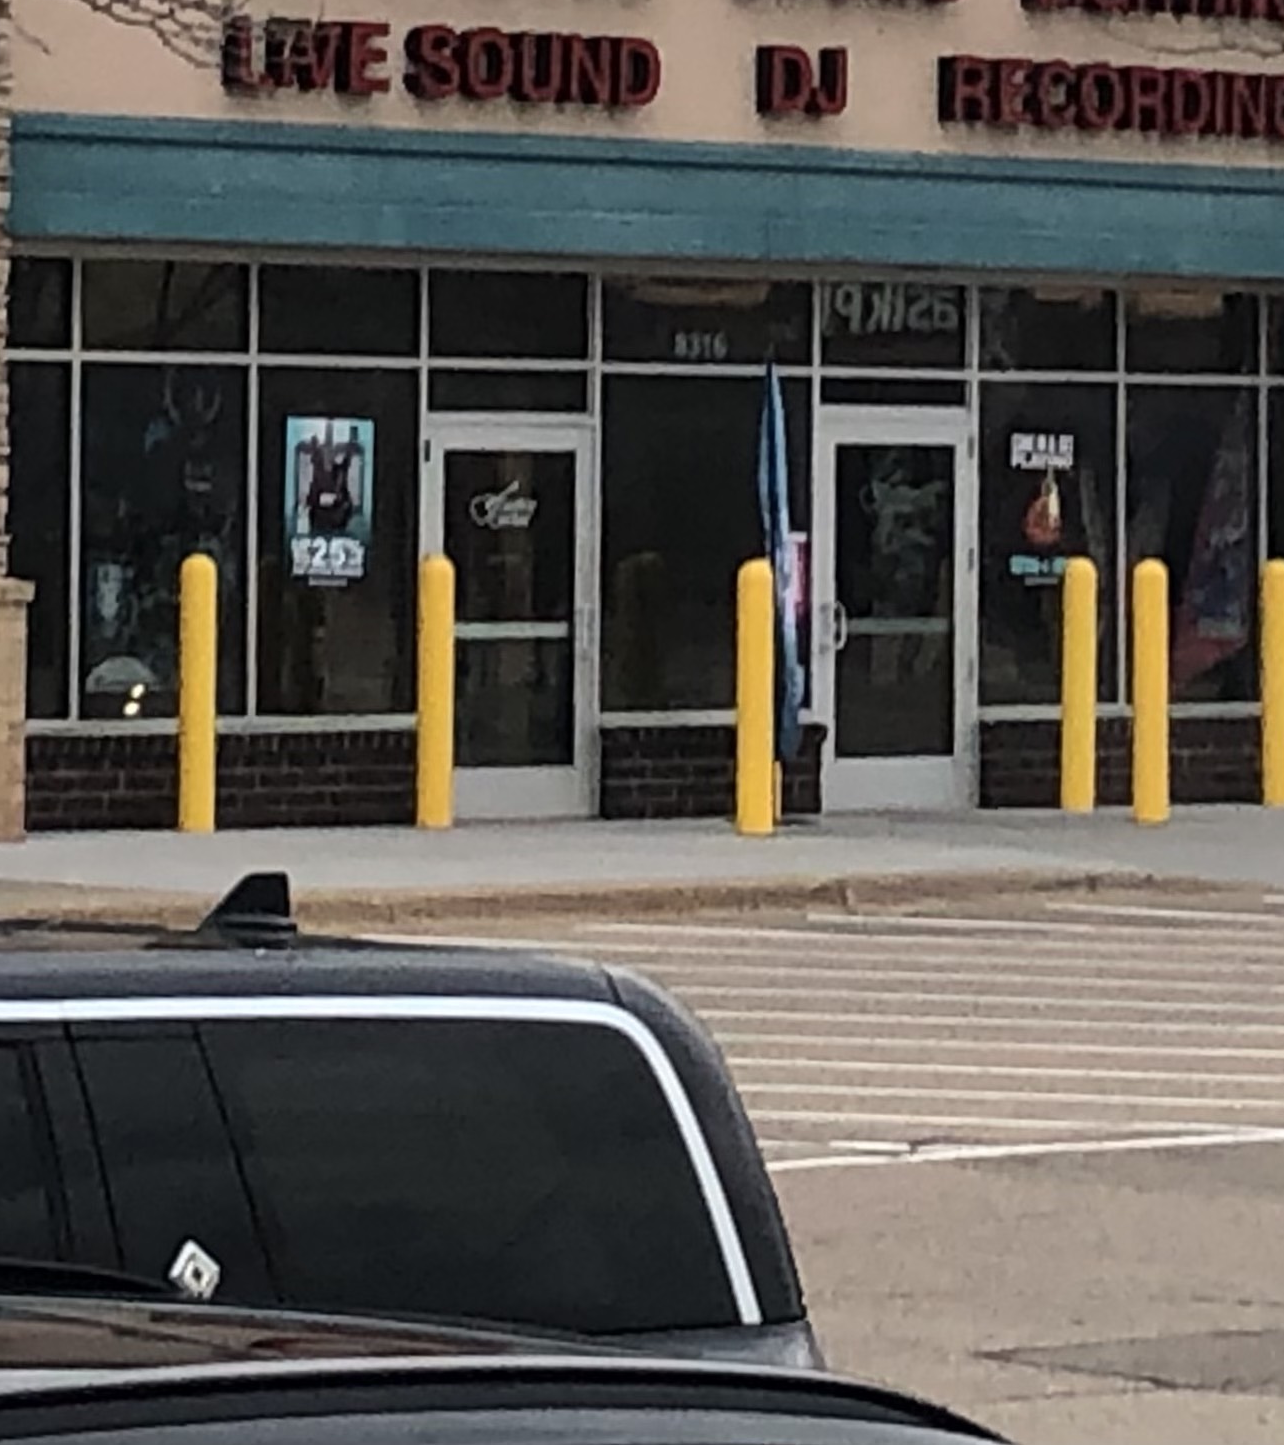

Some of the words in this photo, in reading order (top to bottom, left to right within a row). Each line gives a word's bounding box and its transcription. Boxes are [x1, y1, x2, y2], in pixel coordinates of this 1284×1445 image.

[222, 15, 391, 94] LIVE
[403, 23, 661, 107] SOUND
[756, 45, 848, 115] DJ
